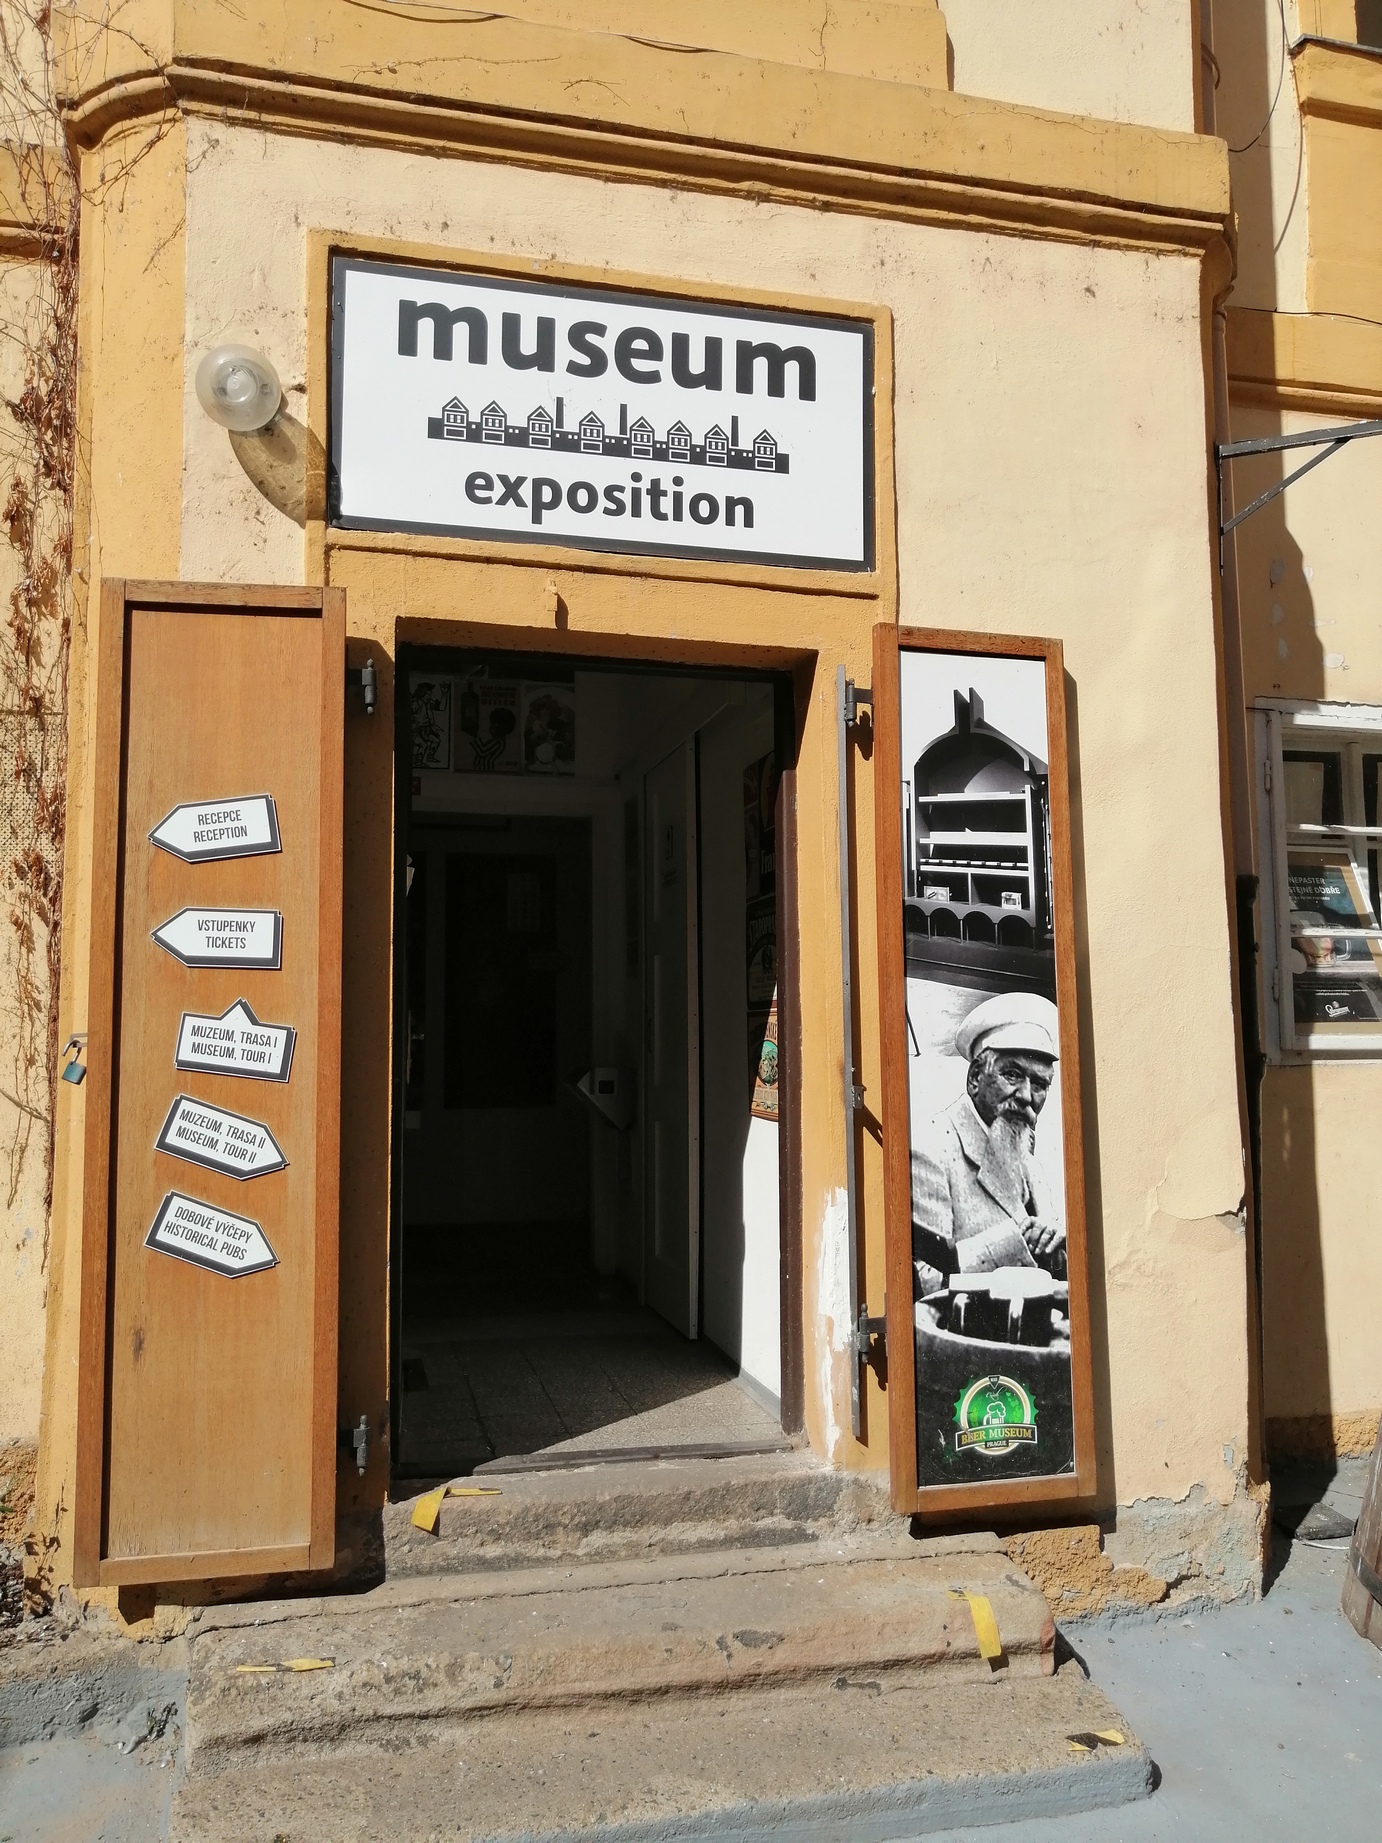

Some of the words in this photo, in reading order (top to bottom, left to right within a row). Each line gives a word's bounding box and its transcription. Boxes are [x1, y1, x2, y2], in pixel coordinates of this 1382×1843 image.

[397, 298, 818, 403] museum
[464, 470, 756, 529] exposition
[197, 809, 242, 826] RECEPCE
[193, 825, 248, 843] RECEPTION
[197, 919, 256, 932] VSTUPENKY
[205, 936, 247, 949] TICKETS
[190, 1024, 237, 1044] MUZEUM,
[240, 1031, 272, 1048] TRASA
[273, 1036, 278, 1048] I
[190, 1041, 237, 1061] MUSEUM,
[240, 1048, 266, 1063] TOUR
[267, 1052, 272, 1064] I
[178, 1108, 224, 1135] MUZEUM,
[226, 1124, 256, 1146] TRASA
[257, 1137, 267, 1149] II
[175, 1125, 220, 1153] MUSEUM,
[222, 1141, 248, 1161] TOUR
[248, 1152, 257, 1164] II
[174, 1206, 215, 1230] DOBOVÉ
[214, 1220, 254, 1244] VÝČEPY
[163, 1220, 219, 1251] HISTORICAL
[219, 1241, 248, 1261] PUBS
[961, 1430, 986, 1445] BEER
[988, 1428, 1032, 1439] MUSEUM
[986, 1440, 1007, 1448] PRAGUE
